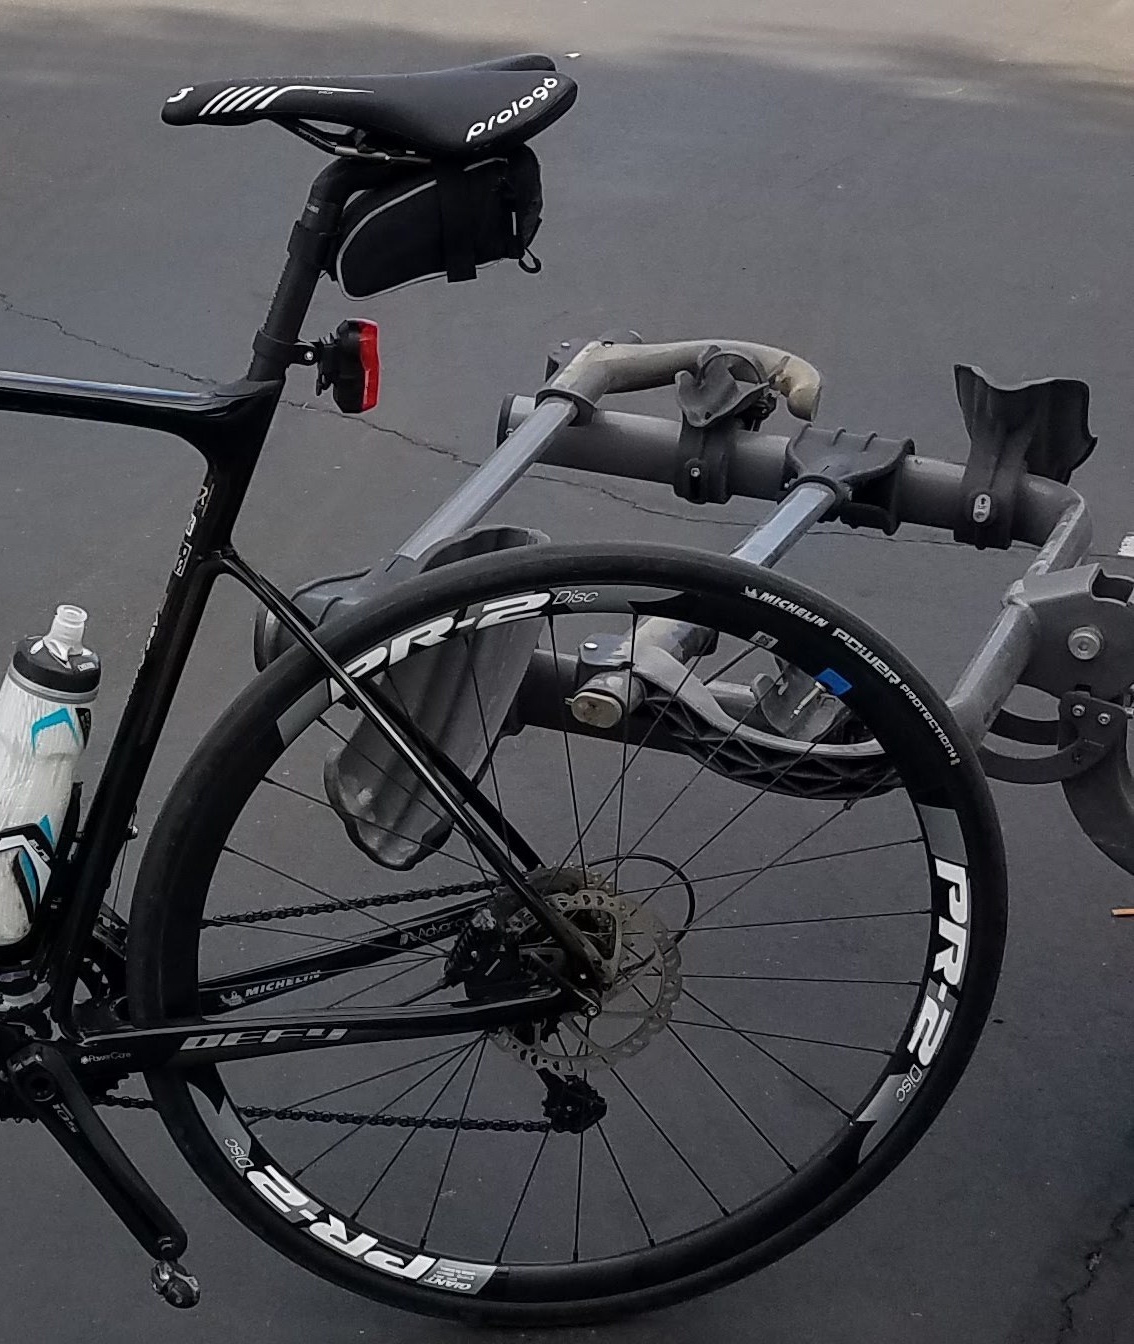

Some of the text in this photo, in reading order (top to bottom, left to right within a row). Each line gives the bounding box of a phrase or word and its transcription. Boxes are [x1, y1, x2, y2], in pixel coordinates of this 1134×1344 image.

[466, 77, 558, 143] prologo
[552, 589, 599, 606] Disc
[759, 592, 829, 628] MICHELIN
[831, 627, 902, 686] POWER
[245, 970, 321, 997] MICHELIN
[896, 858, 968, 1103] PR-2 Disc
[89, 1051, 131, 1063] PowerCore
[225, 1138, 436, 1280] PR-2 Disc
[424, 1274, 472, 1290] GIANT
